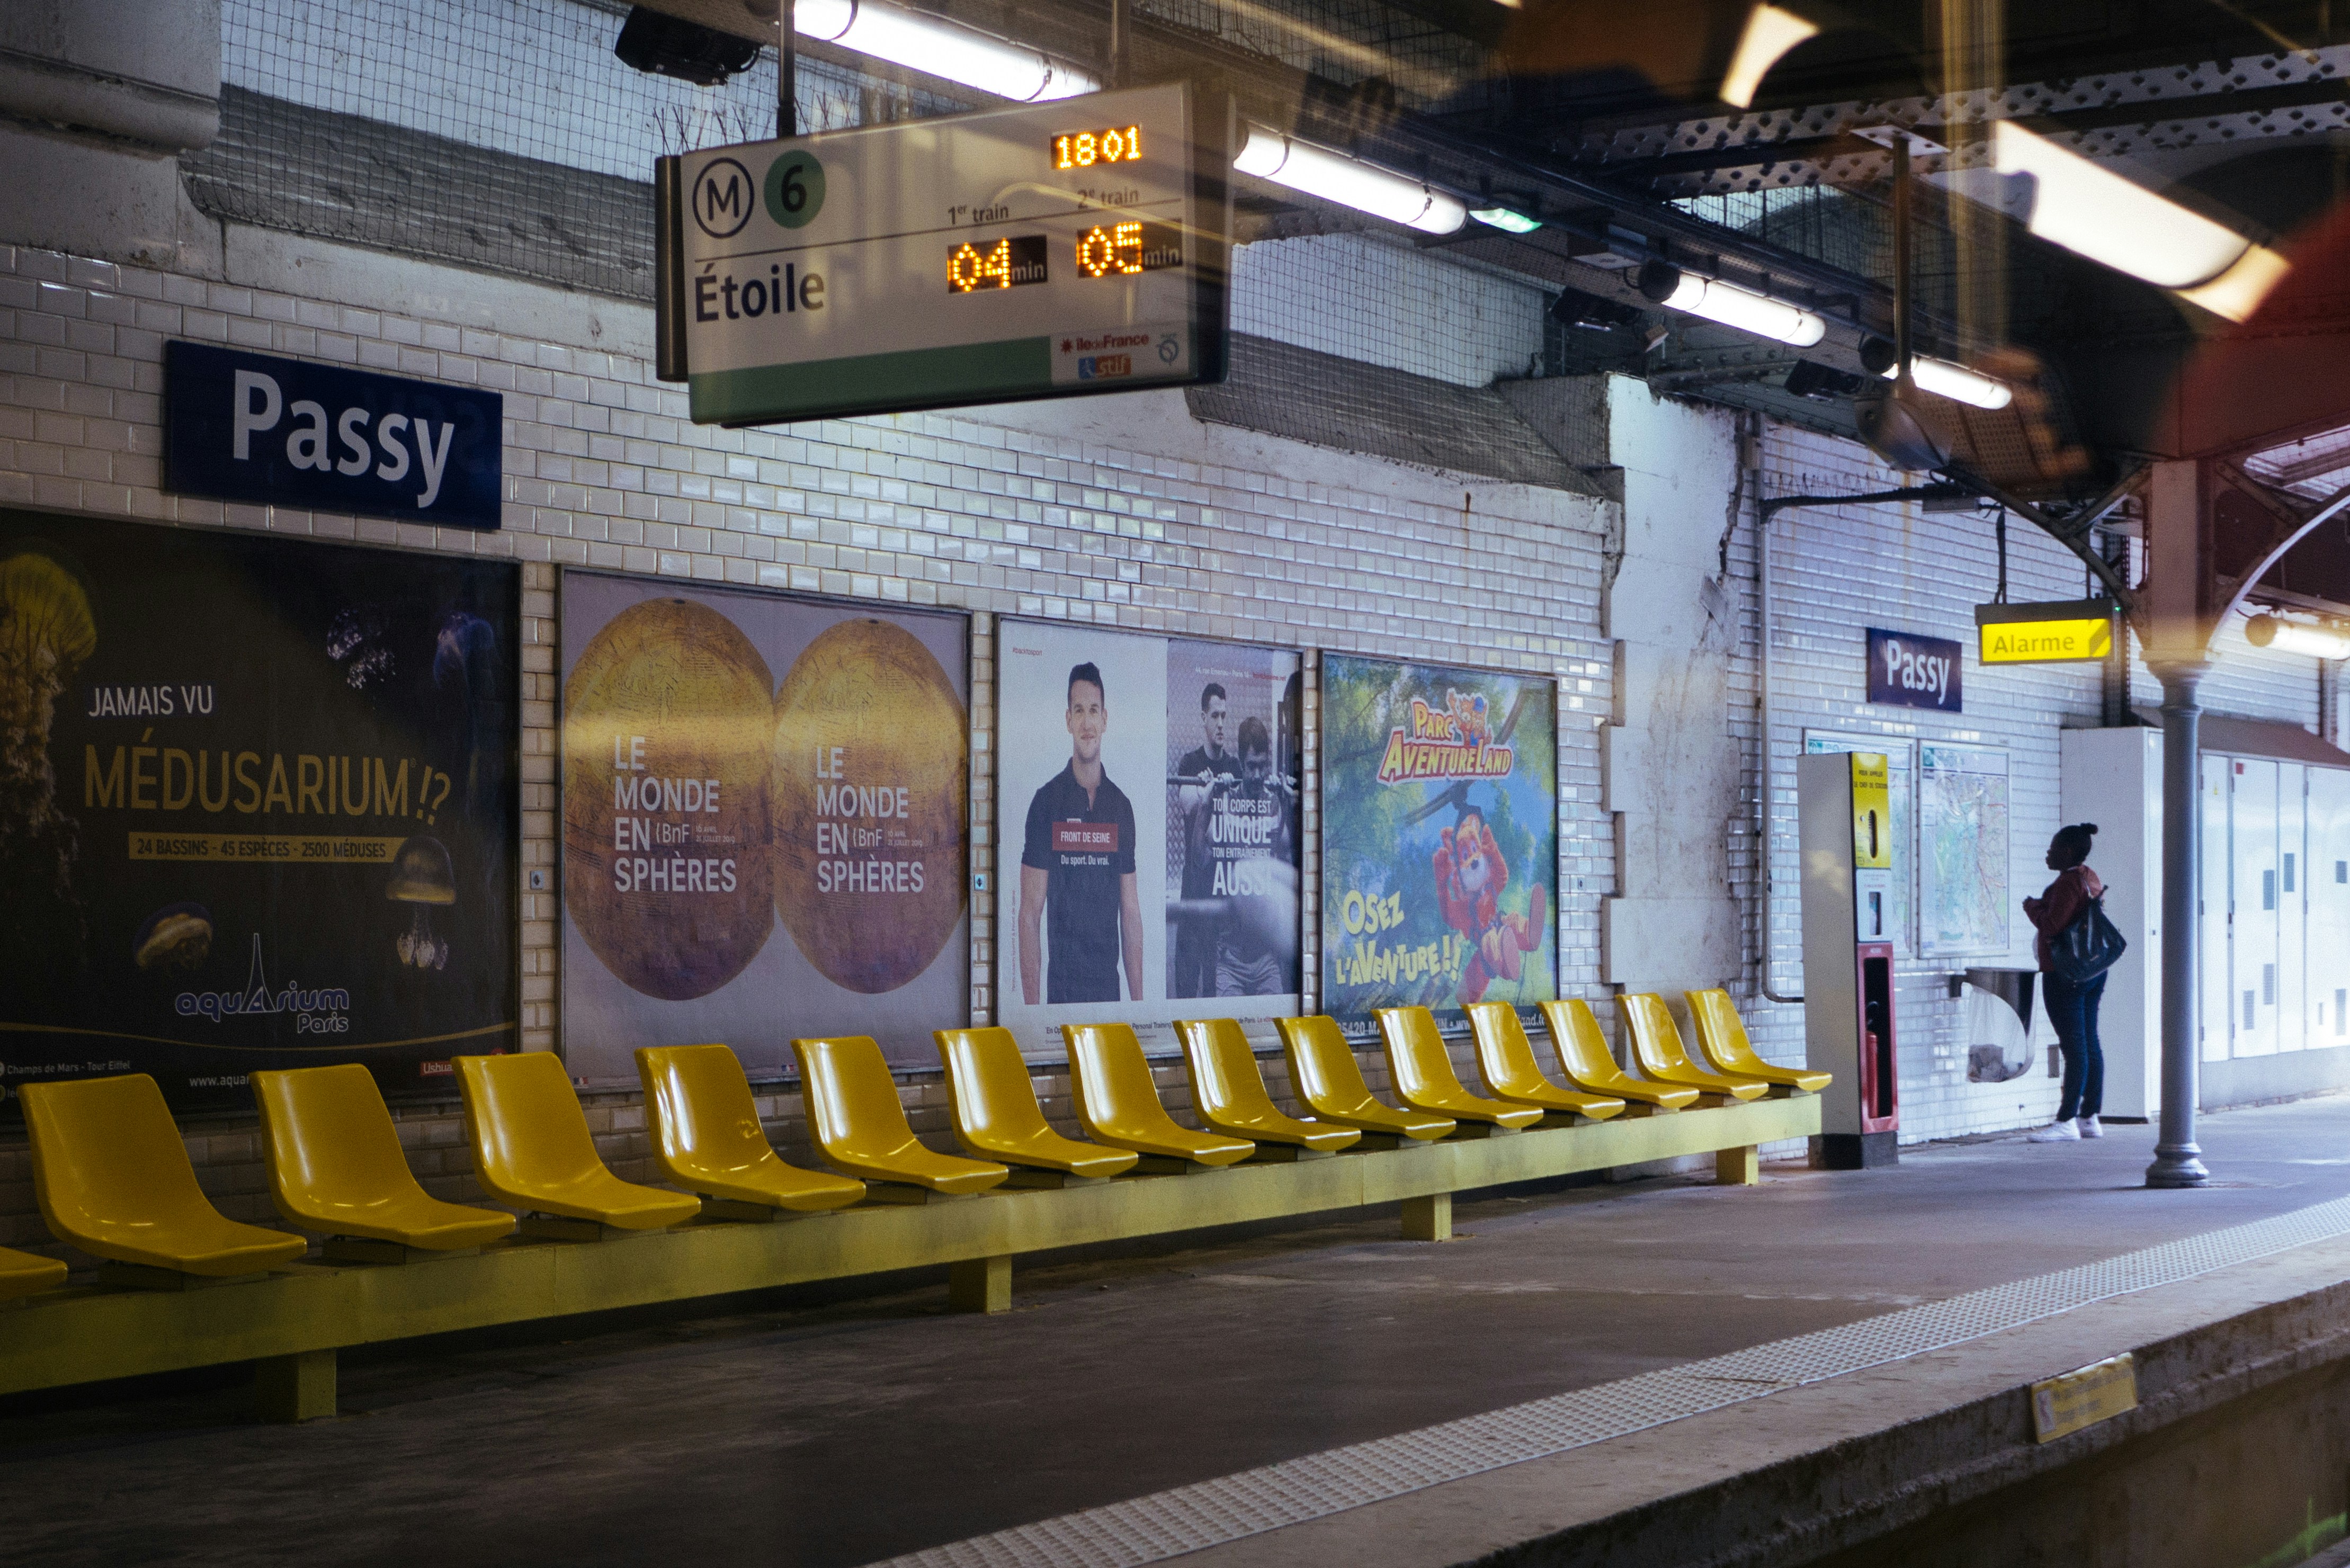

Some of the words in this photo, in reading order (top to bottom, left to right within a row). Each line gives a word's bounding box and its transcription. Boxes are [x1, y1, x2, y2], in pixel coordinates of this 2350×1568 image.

[781, 164, 807, 212] 6
[1101, 187, 1139, 205] train
[972, 204, 1009, 222] train
[952, 238, 1011, 292] 04
[1011, 260, 1044, 281] min
[1082, 221, 1142, 277] 05
[1144, 246, 1179, 266] min
[695, 262, 824, 322] Étoile
[234, 369, 454, 508] Passy
[1994, 634, 2075, 655] Alarme
[1887, 639, 1950, 705] Passy
[89, 686, 173, 717] JAMAIS
[182, 685, 212, 714] VU
[615, 736, 645, 770] LE
[817, 747, 844, 780] LE
[615, 776, 720, 813] MONDE
[817, 785, 909, 819] MONDE
[1230, 799, 1256, 813] CORPS
[1258, 800, 1272, 813] EST
[615, 817, 650, 852] EN
[817, 822, 848, 855] EN
[1061, 831, 1081, 843] FRONT
[1083, 832, 1091, 843] DE
[1092, 832, 1110, 843] SEINE
[1212, 814, 1272, 846] UNIQUE
[137, 838, 152, 855] 24
[156, 839, 208, 856] BASSINS
[220, 840, 235, 856] 45
[239, 837, 290, 857] ESPÈCES
[301, 843, 330, 857] 2500
[334, 838, 386, 858] MÉDUSES
[1061, 854, 1069, 865] Du
[1070, 855, 1087, 867] sport.
[1088, 855, 1096, 865] Du
[1097, 855, 1110, 865] vrai.
[1212, 847, 1225, 858] TON
[614, 850, 737, 893] SPHÈRES
[817, 851, 924, 893] SPHÈRES
[298, 1011, 349, 1033] Paris
[7, 1065, 42, 1075] Champs
[44, 1064, 55, 1073] de
[58, 1063, 79, 1072] Mars
[87, 1061, 105, 1071] Tour
[108, 1060, 131, 1070] Eiffel
